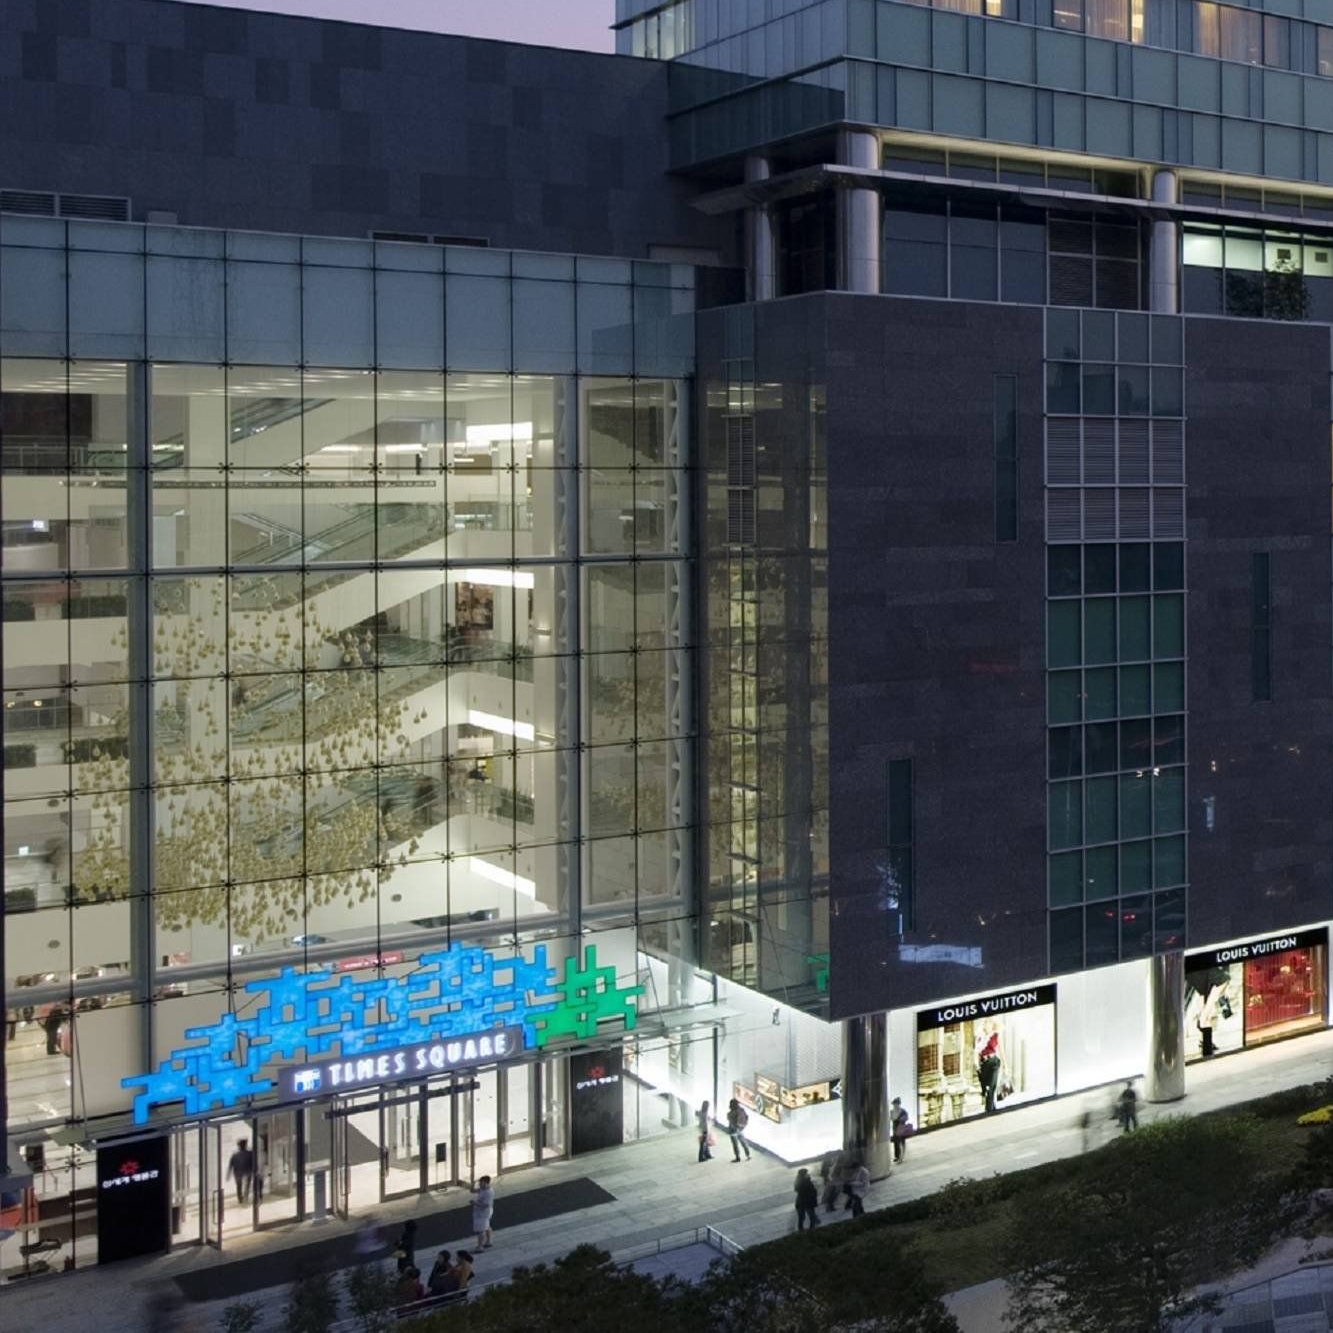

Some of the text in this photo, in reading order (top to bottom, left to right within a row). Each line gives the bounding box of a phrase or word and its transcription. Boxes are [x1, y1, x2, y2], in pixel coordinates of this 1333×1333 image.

[1216, 936, 1297, 963] LOUIS VUITTON
[938, 991, 1038, 1022] LOUIS VUITTON
[329, 1032, 507, 1086] TIMES SQUARE
